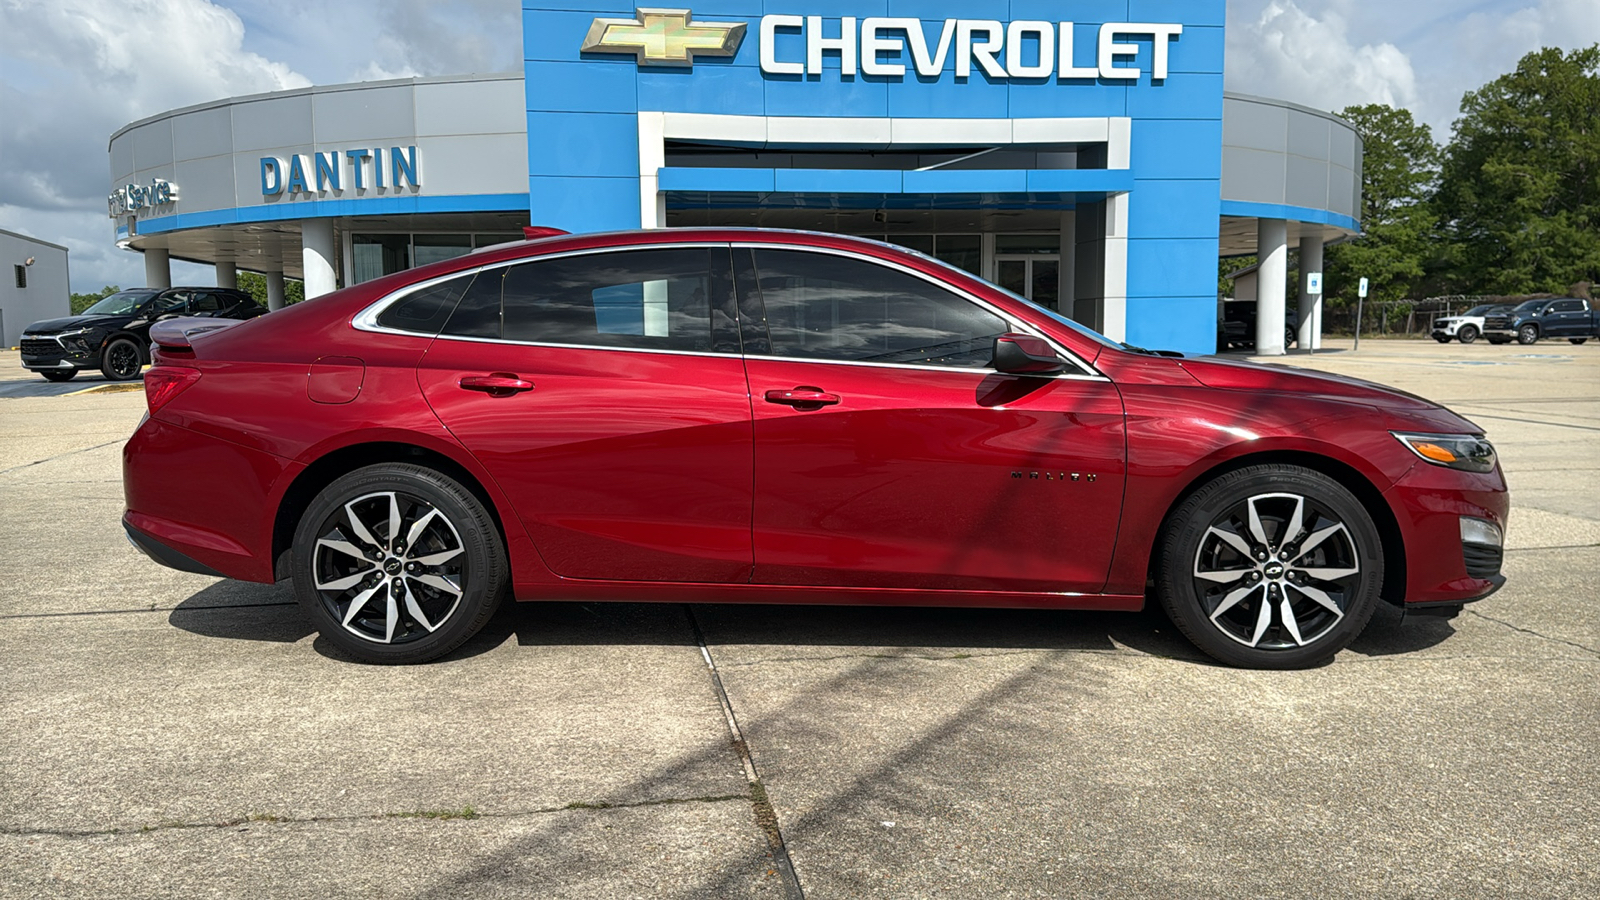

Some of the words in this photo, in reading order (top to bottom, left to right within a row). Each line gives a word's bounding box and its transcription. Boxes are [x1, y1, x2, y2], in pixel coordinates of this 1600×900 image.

[759, 14, 1184, 80] CHEVROLET
[259, 145, 420, 197] DANTIN
[128, 178, 177, 210] Service
[1010, 471, 1097, 482] MALIBU
